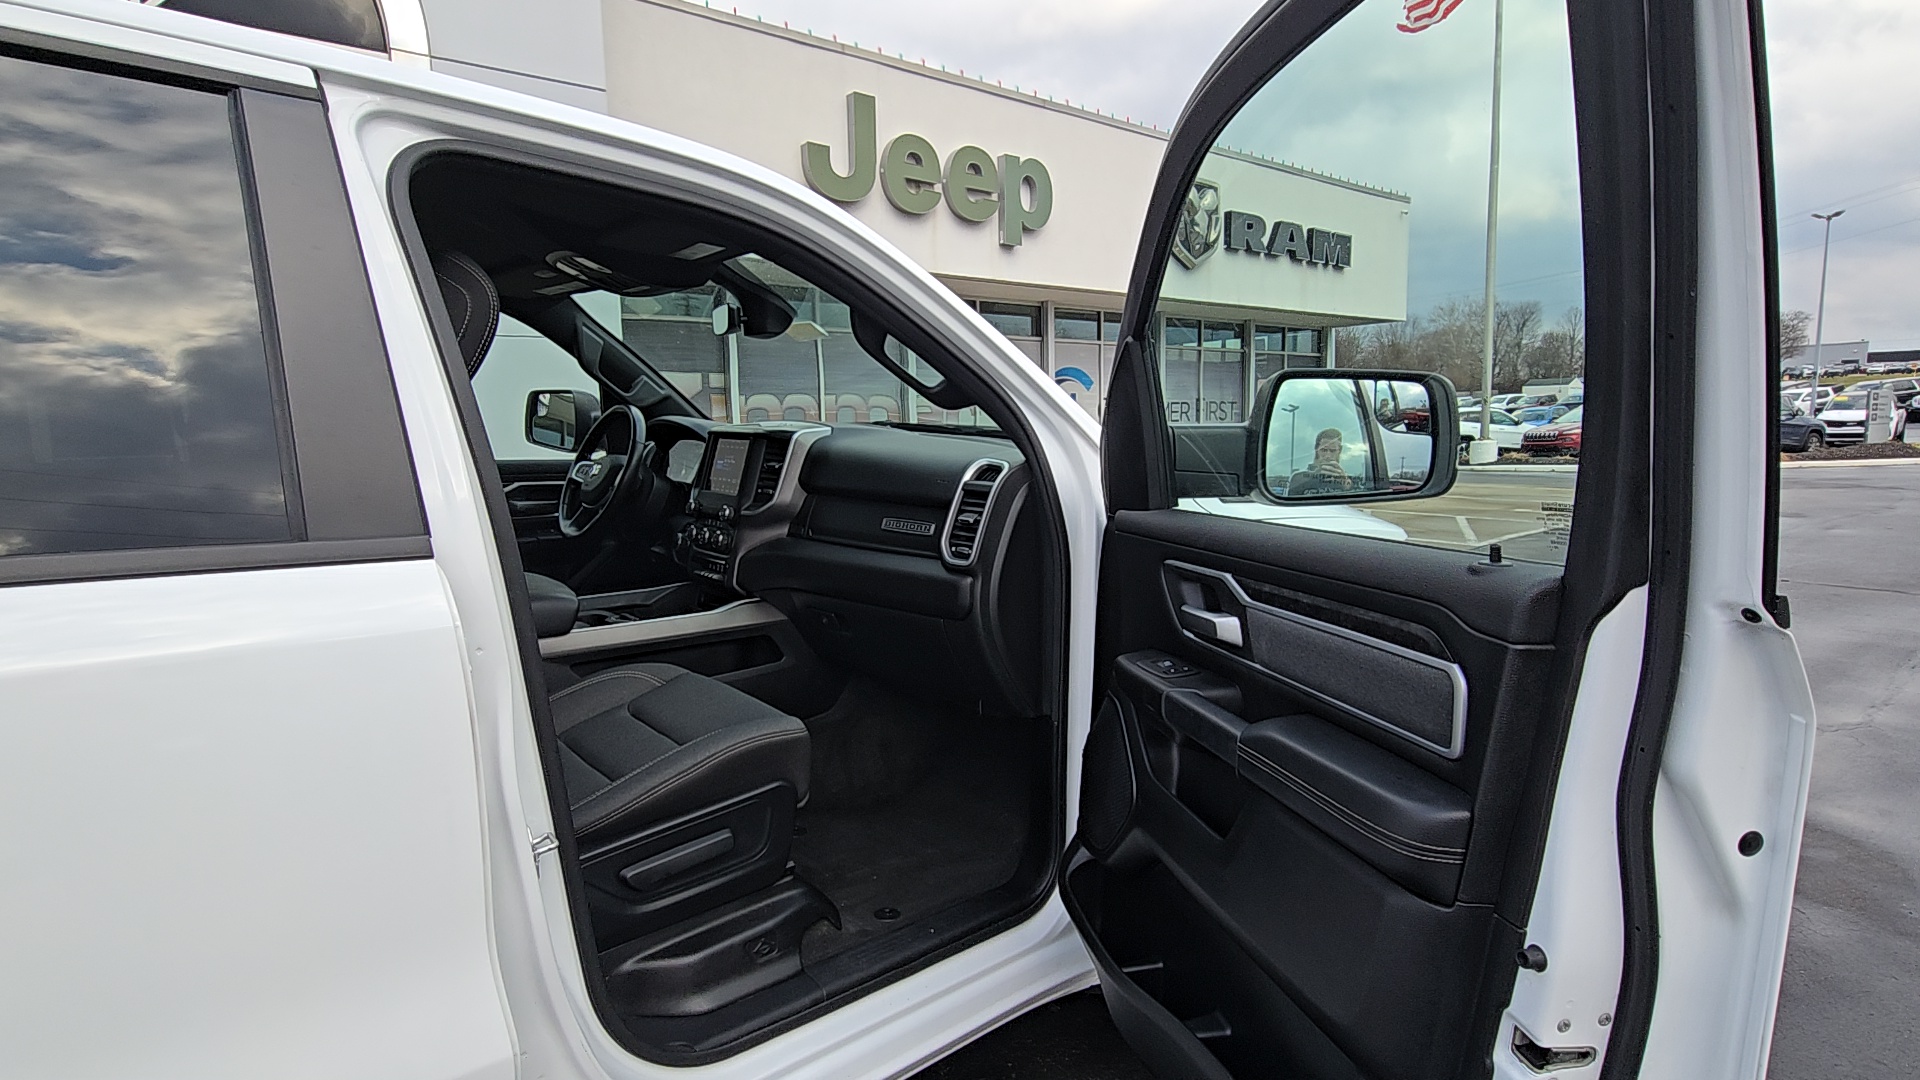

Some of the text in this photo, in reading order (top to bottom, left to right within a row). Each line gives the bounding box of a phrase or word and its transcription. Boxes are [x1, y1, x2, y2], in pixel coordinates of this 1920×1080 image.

[801, 91, 1053, 247] Jeep
[1223, 210, 1353, 268] RAM
[1195, 397, 1238, 423] FIRST
